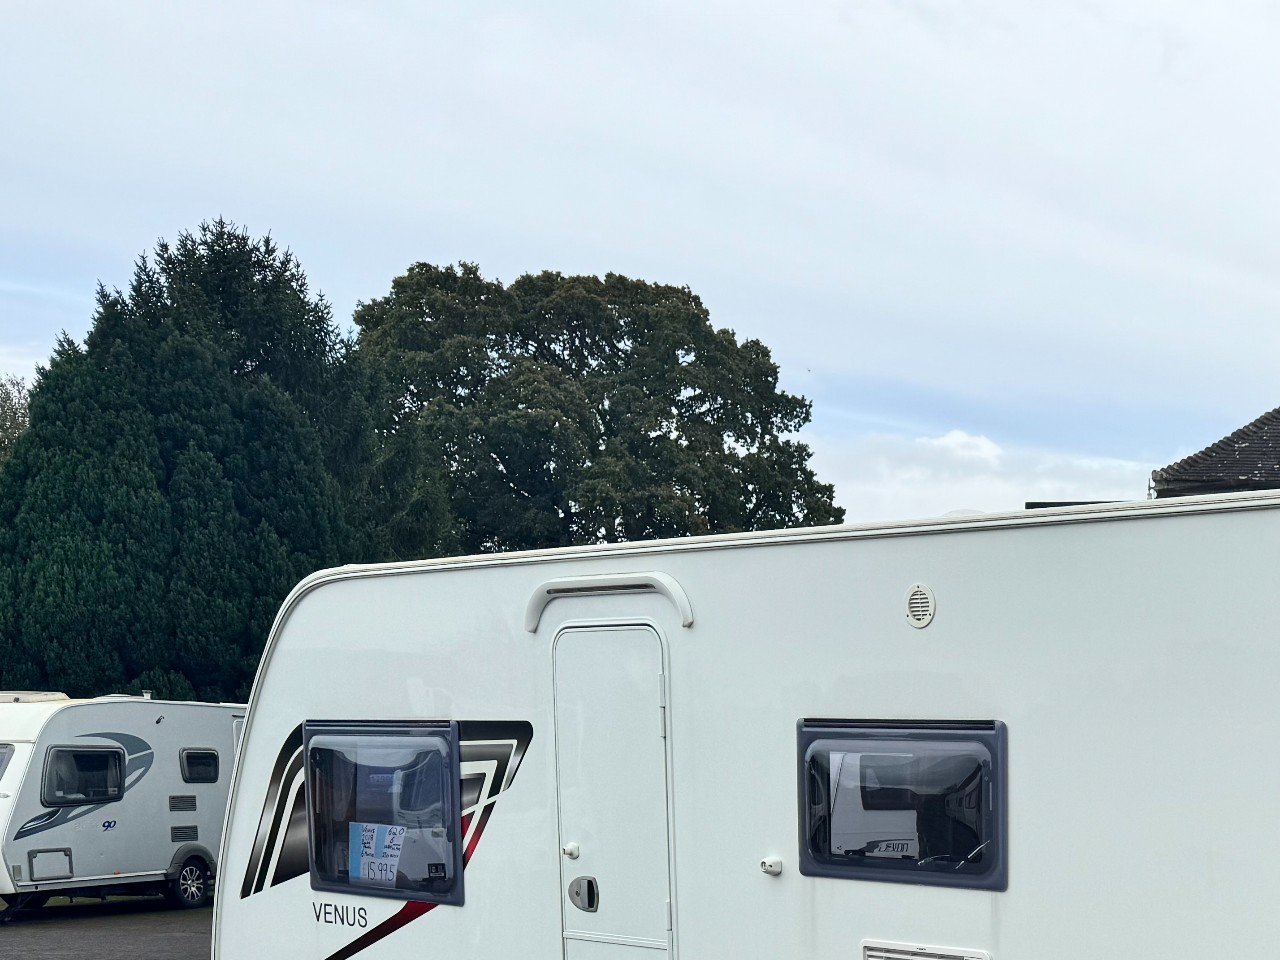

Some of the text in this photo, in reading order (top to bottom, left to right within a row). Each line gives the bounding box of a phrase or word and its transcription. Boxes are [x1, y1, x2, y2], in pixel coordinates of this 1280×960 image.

[102, 820, 117, 832] 90
[388, 827, 405, 836] 620
[312, 901, 368, 928] VENUS
